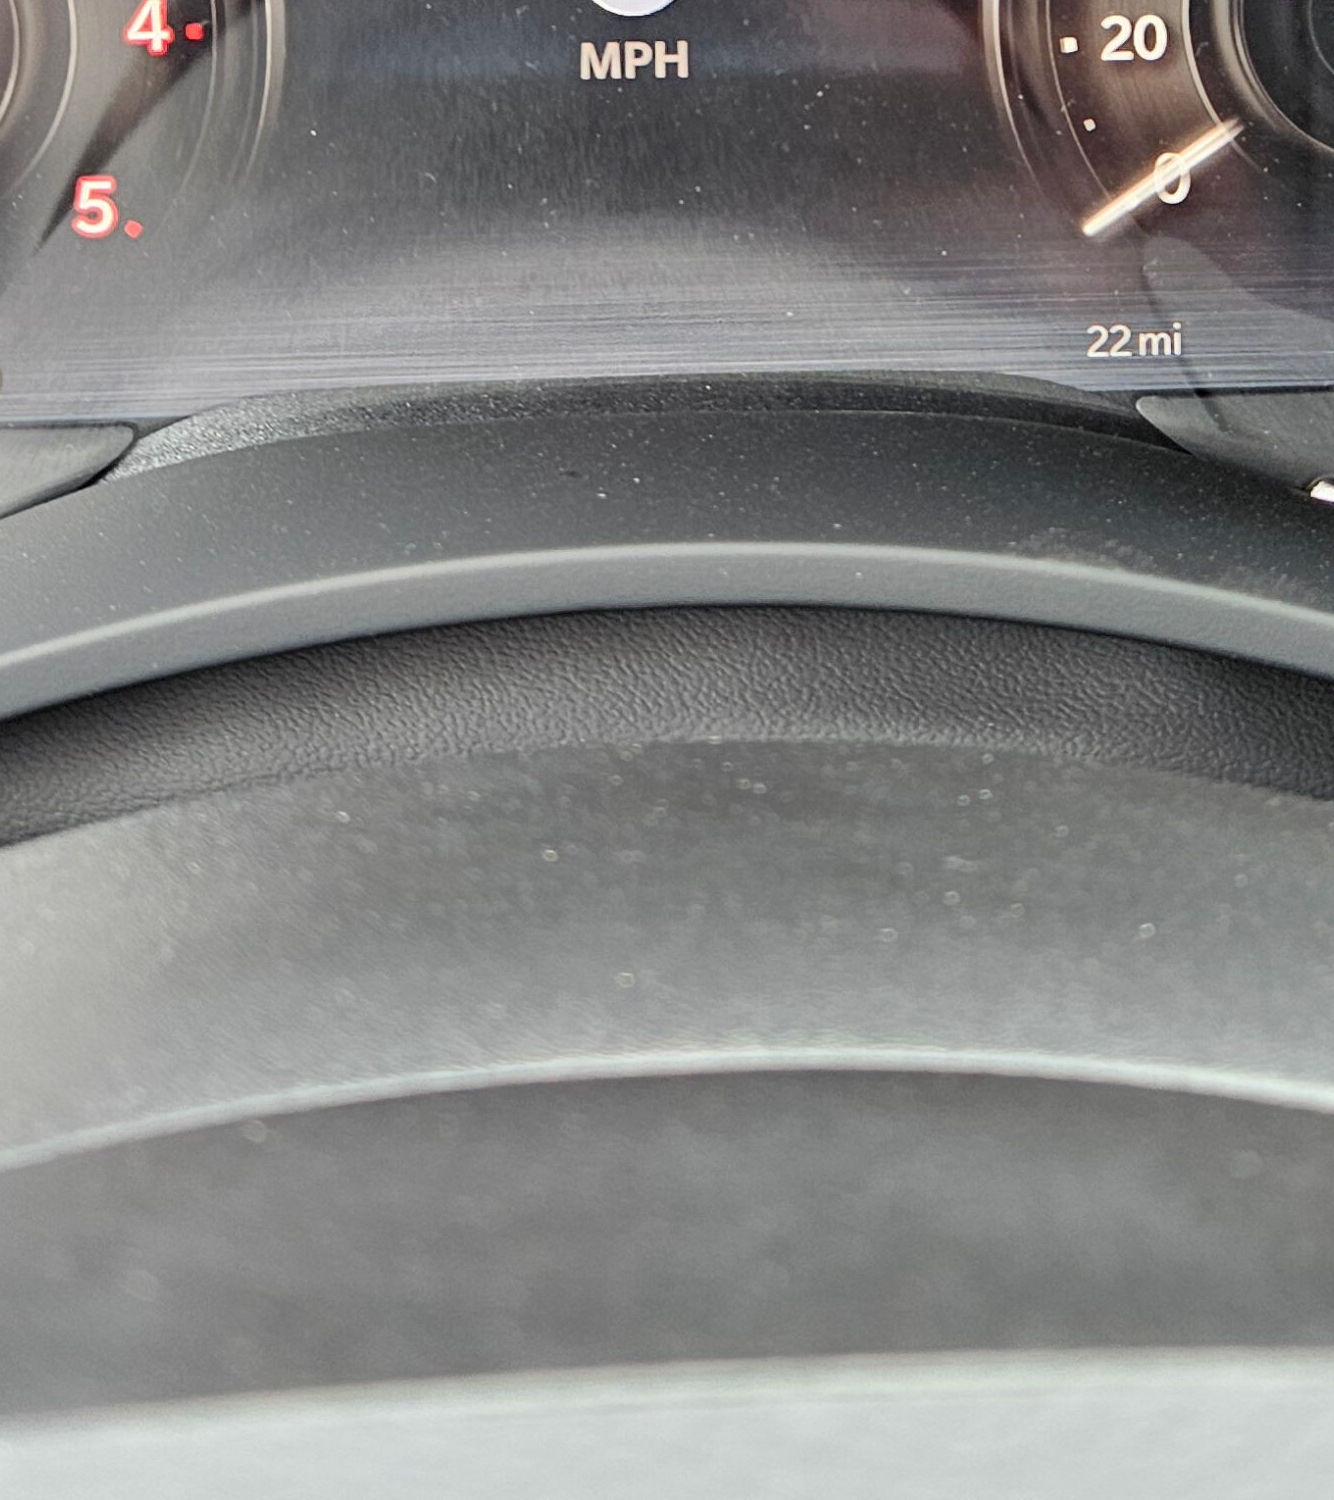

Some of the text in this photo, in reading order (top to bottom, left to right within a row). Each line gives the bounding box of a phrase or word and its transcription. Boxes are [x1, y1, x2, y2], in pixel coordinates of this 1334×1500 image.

[579, 40, 689, 80] MPH
[1100, 15, 1168, 61] 20
[1153, 152, 1192, 205] 0
[72, 176, 117, 237] 5
